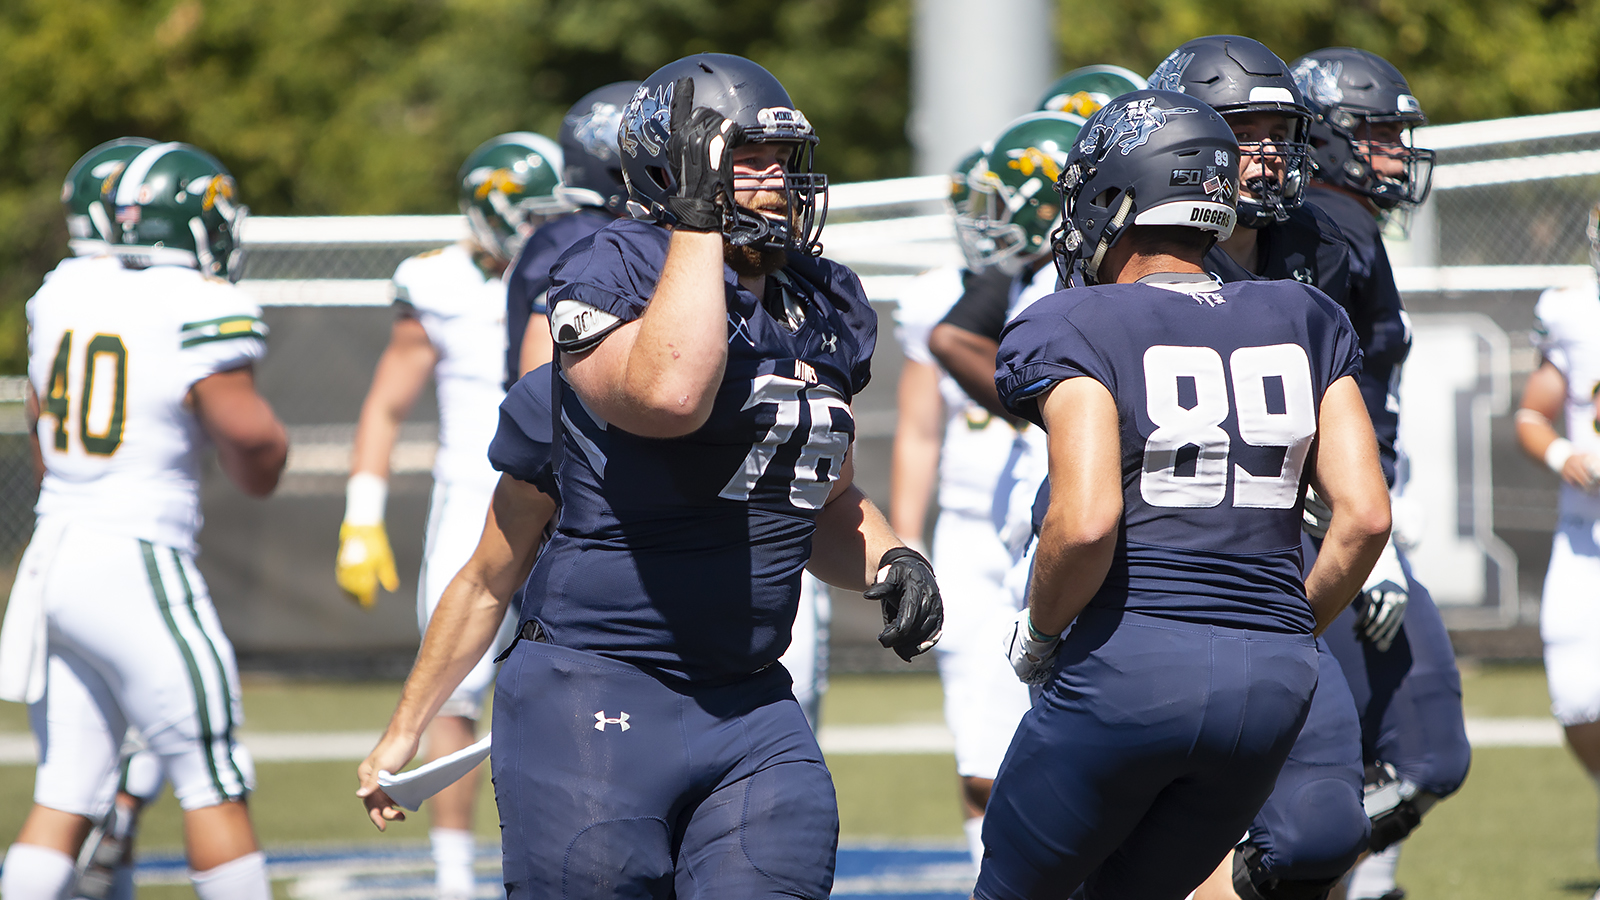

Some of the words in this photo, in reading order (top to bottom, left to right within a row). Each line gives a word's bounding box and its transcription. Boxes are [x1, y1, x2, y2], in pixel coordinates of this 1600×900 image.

[1172, 169, 1202, 186] 150
[1214, 149, 1230, 167] 89
[1190, 207, 1231, 228] DIGGERS
[39, 329, 128, 457] 40
[1139, 344, 1317, 510] 89
[717, 374, 854, 510] 76
